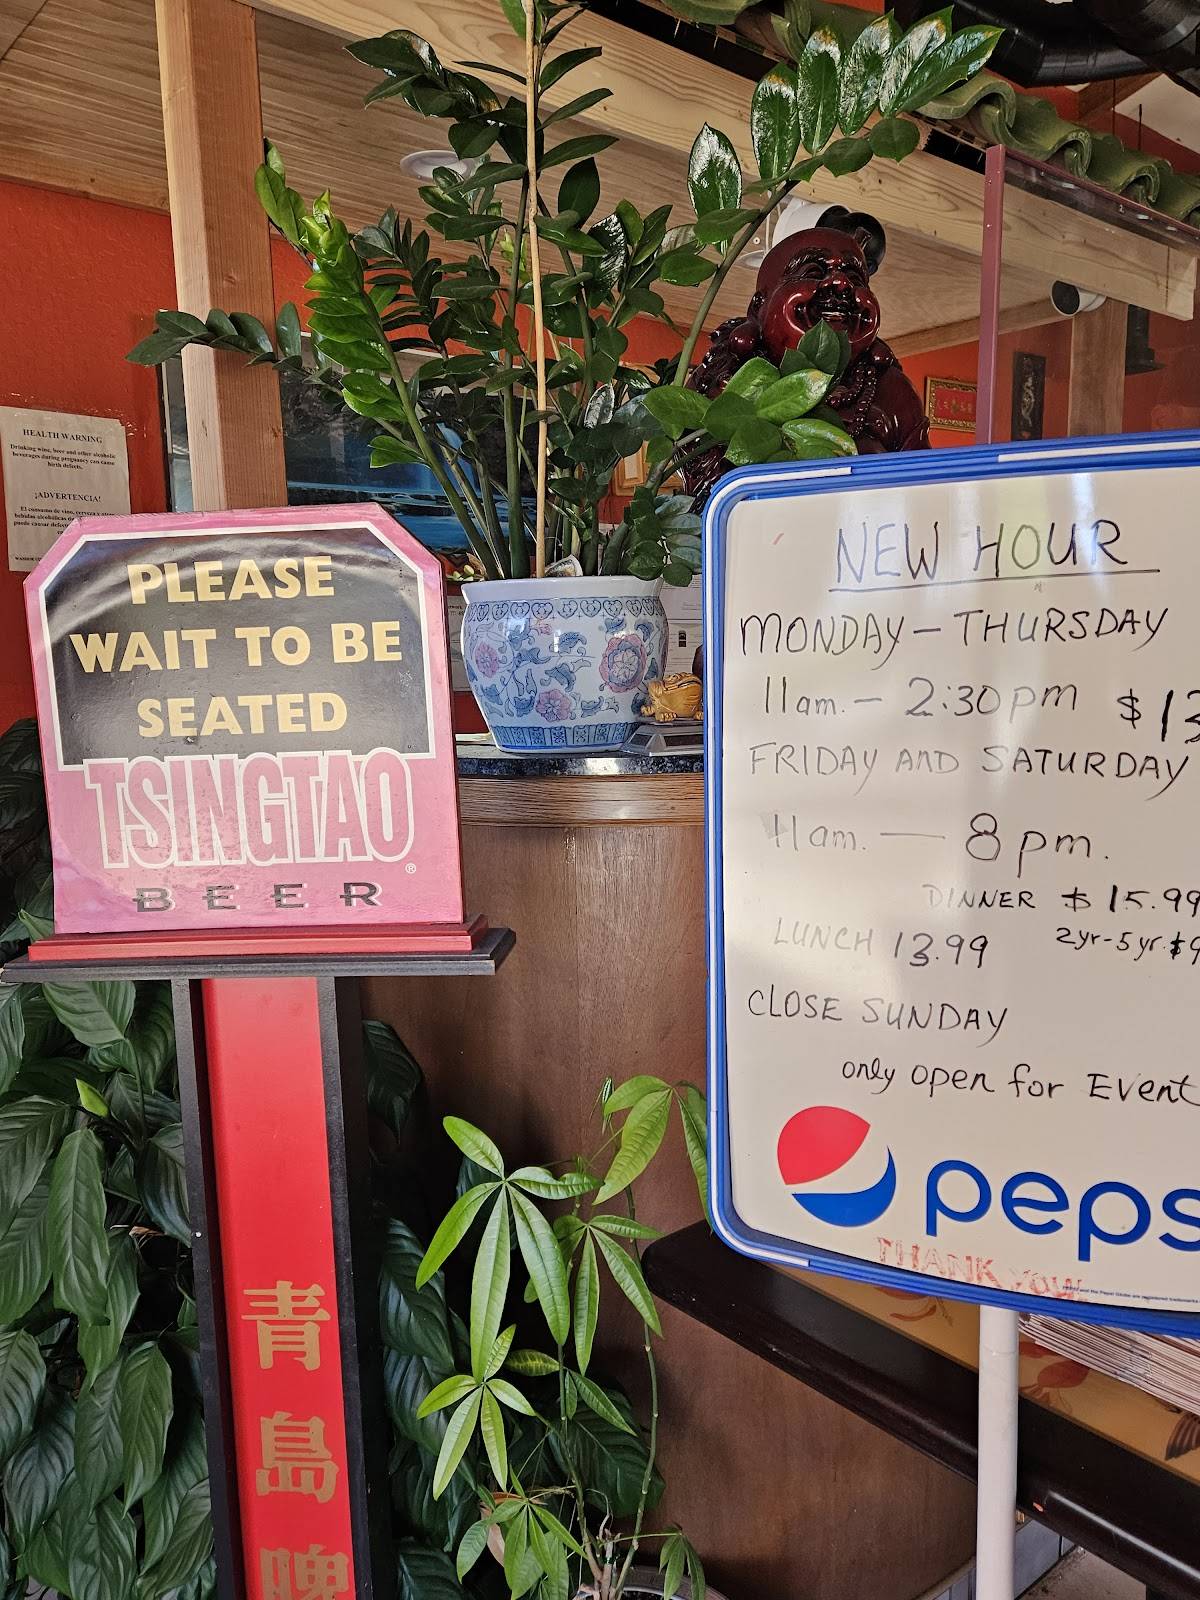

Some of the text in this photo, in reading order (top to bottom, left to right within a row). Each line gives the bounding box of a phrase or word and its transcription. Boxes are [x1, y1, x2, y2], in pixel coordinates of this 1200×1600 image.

[10, 444, 36, 452] Drinking
[12, 451, 40, 459] beverages
[41, 454, 60, 462] during
[61, 456, 88, 465] pregnancy
[23, 429, 103, 444] HEALTH WARNING
[34, 491, 101, 503] ¡ADVERTENCIA!
[836, 519, 1128, 584] NEW HOUR
[127, 555, 335, 605] PLEASE
[69, 620, 403, 673] WAIT TO BE
[741, 611, 904, 671] MONDAY
[954, 607, 1169, 652] THURSDAY
[137, 692, 349, 738] SEATED
[749, 741, 1189, 801] FRIDAY AND SATURDAY
[83, 746, 415, 870] TSINGTAO
[132, 881, 383, 914] BEER
[922, 883, 1036, 910] DINNER
[774, 917, 989, 969] LUNCH 13.99
[748, 984, 1008, 1048] CLOSE SUNDAY
[842, 1057, 895, 1095] only
[911, 1064, 995, 1098] open
[1008, 1063, 1065, 1099] for
[874, 1236, 1001, 1289] THANK
